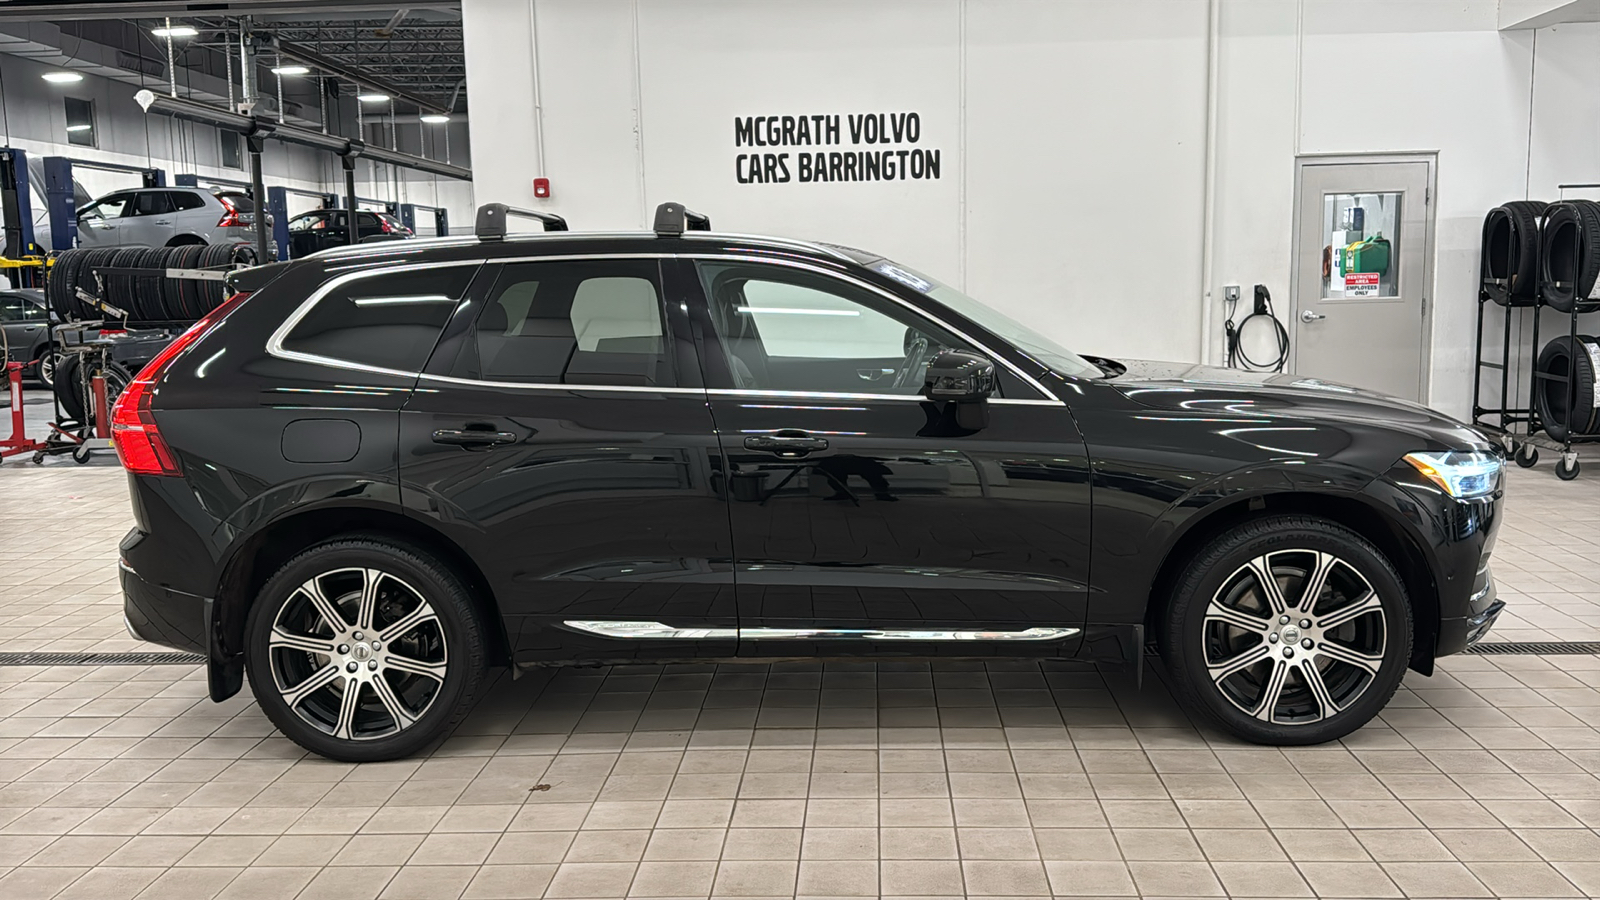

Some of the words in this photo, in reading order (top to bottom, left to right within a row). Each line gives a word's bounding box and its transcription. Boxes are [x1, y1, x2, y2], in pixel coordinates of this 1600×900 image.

[735, 115, 840, 147] MCGRATH
[848, 112, 920, 145] VOLVO
[736, 153, 791, 183] CARS
[798, 149, 941, 183] BARRINGTON
